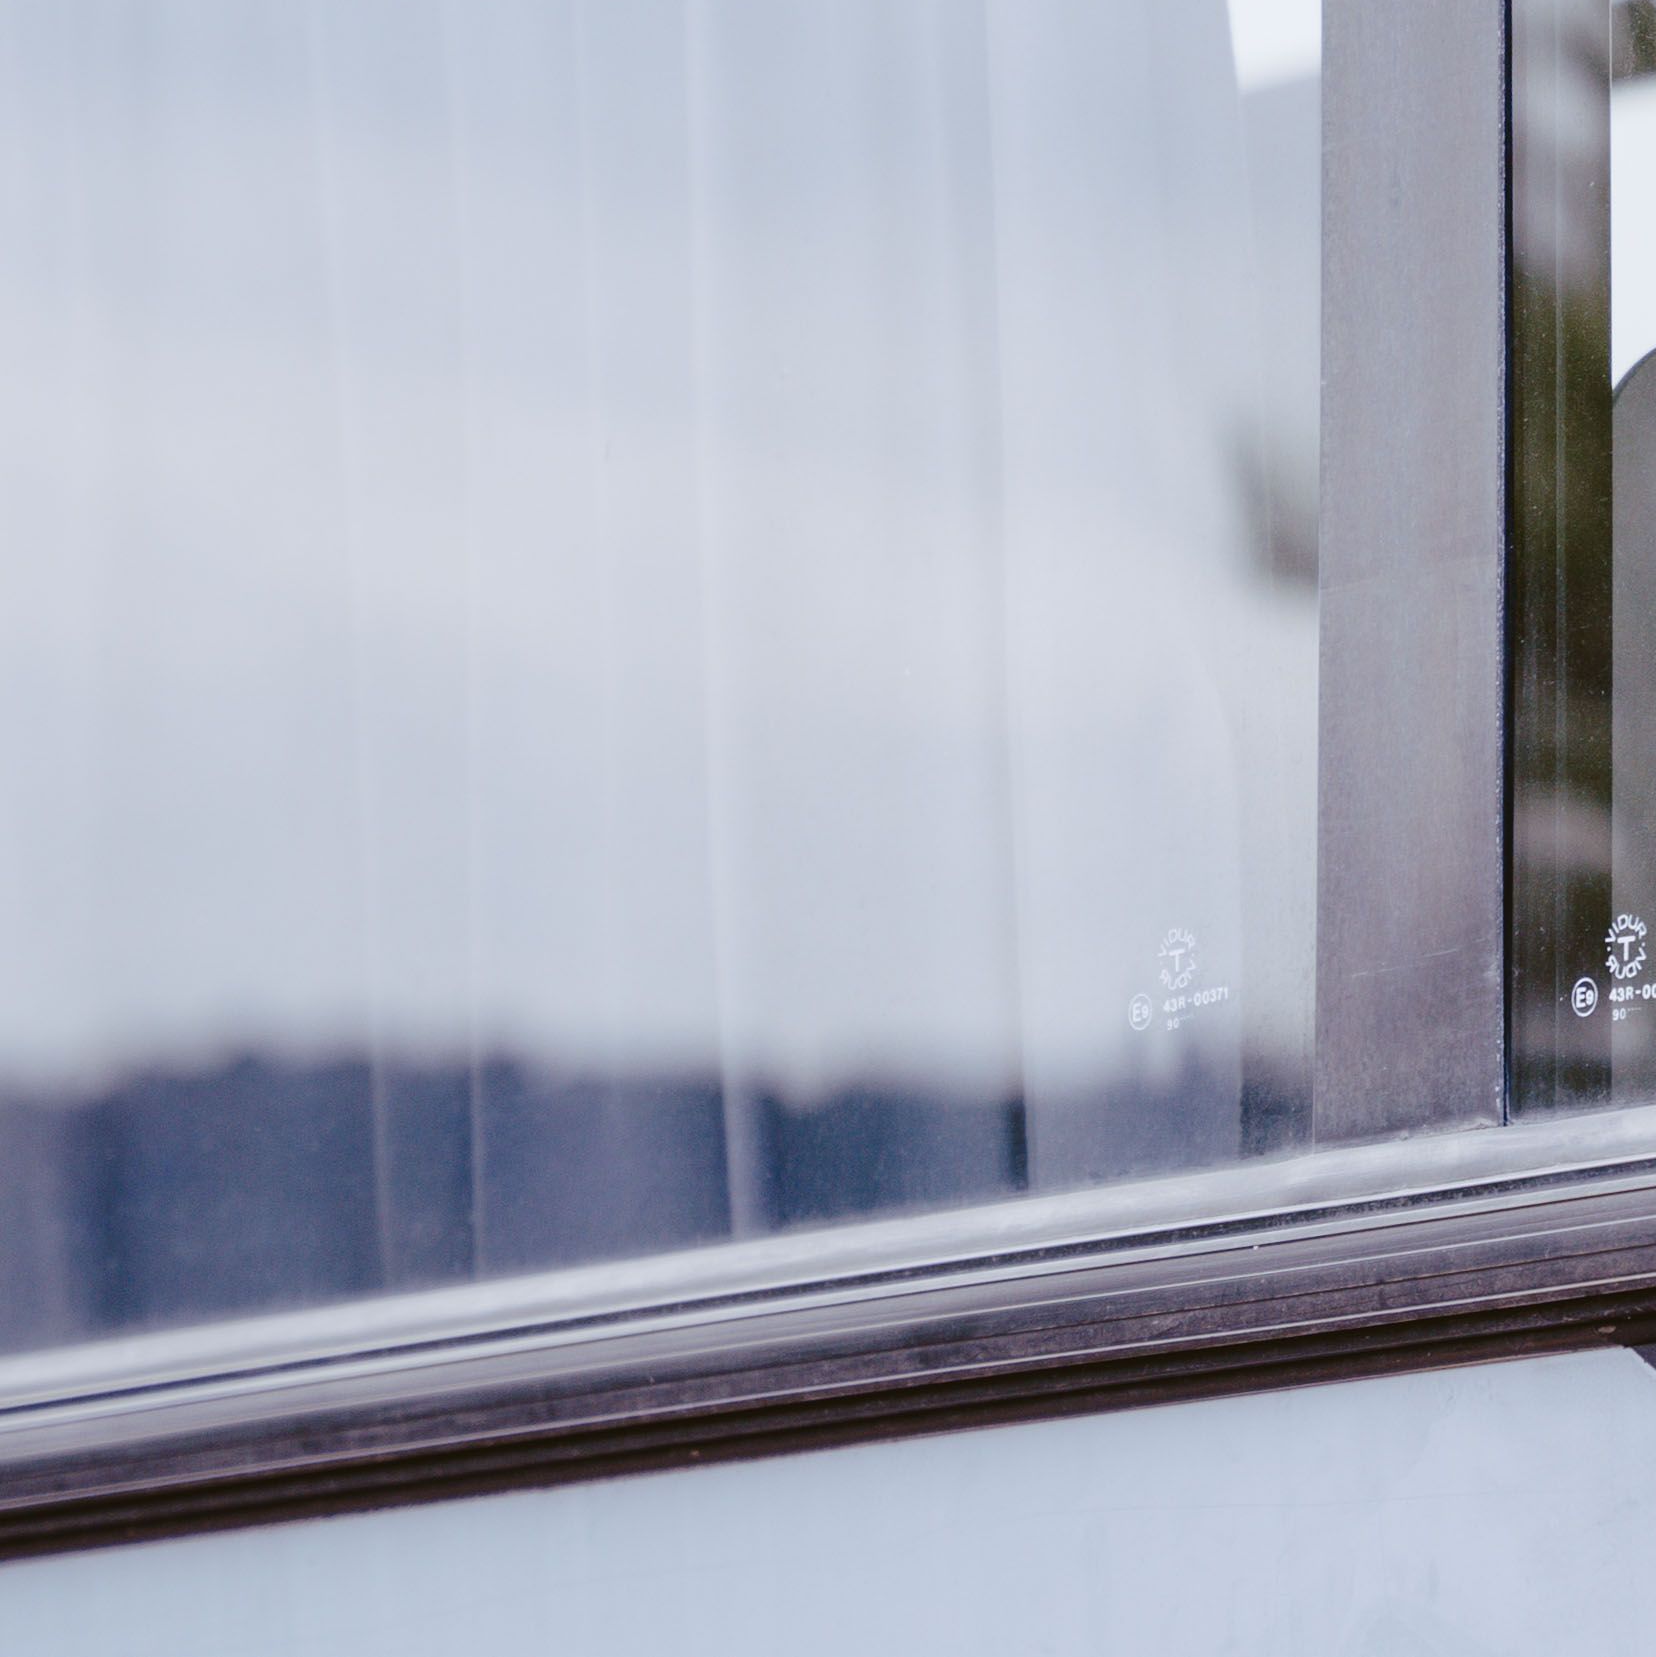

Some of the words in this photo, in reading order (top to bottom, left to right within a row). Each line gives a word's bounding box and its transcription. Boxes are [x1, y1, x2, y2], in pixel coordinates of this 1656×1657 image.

[1604, 914, 1647, 943] VIDUR
[1168, 948, 1186, 972] T
[1617, 935, 1636, 962] T
[1605, 947, 1647, 979] VIDUR
[1163, 987, 1228, 1013] 43R-00371
[1575, 987, 1594, 1008] E9
[1132, 1001, 1149, 1022] E9
